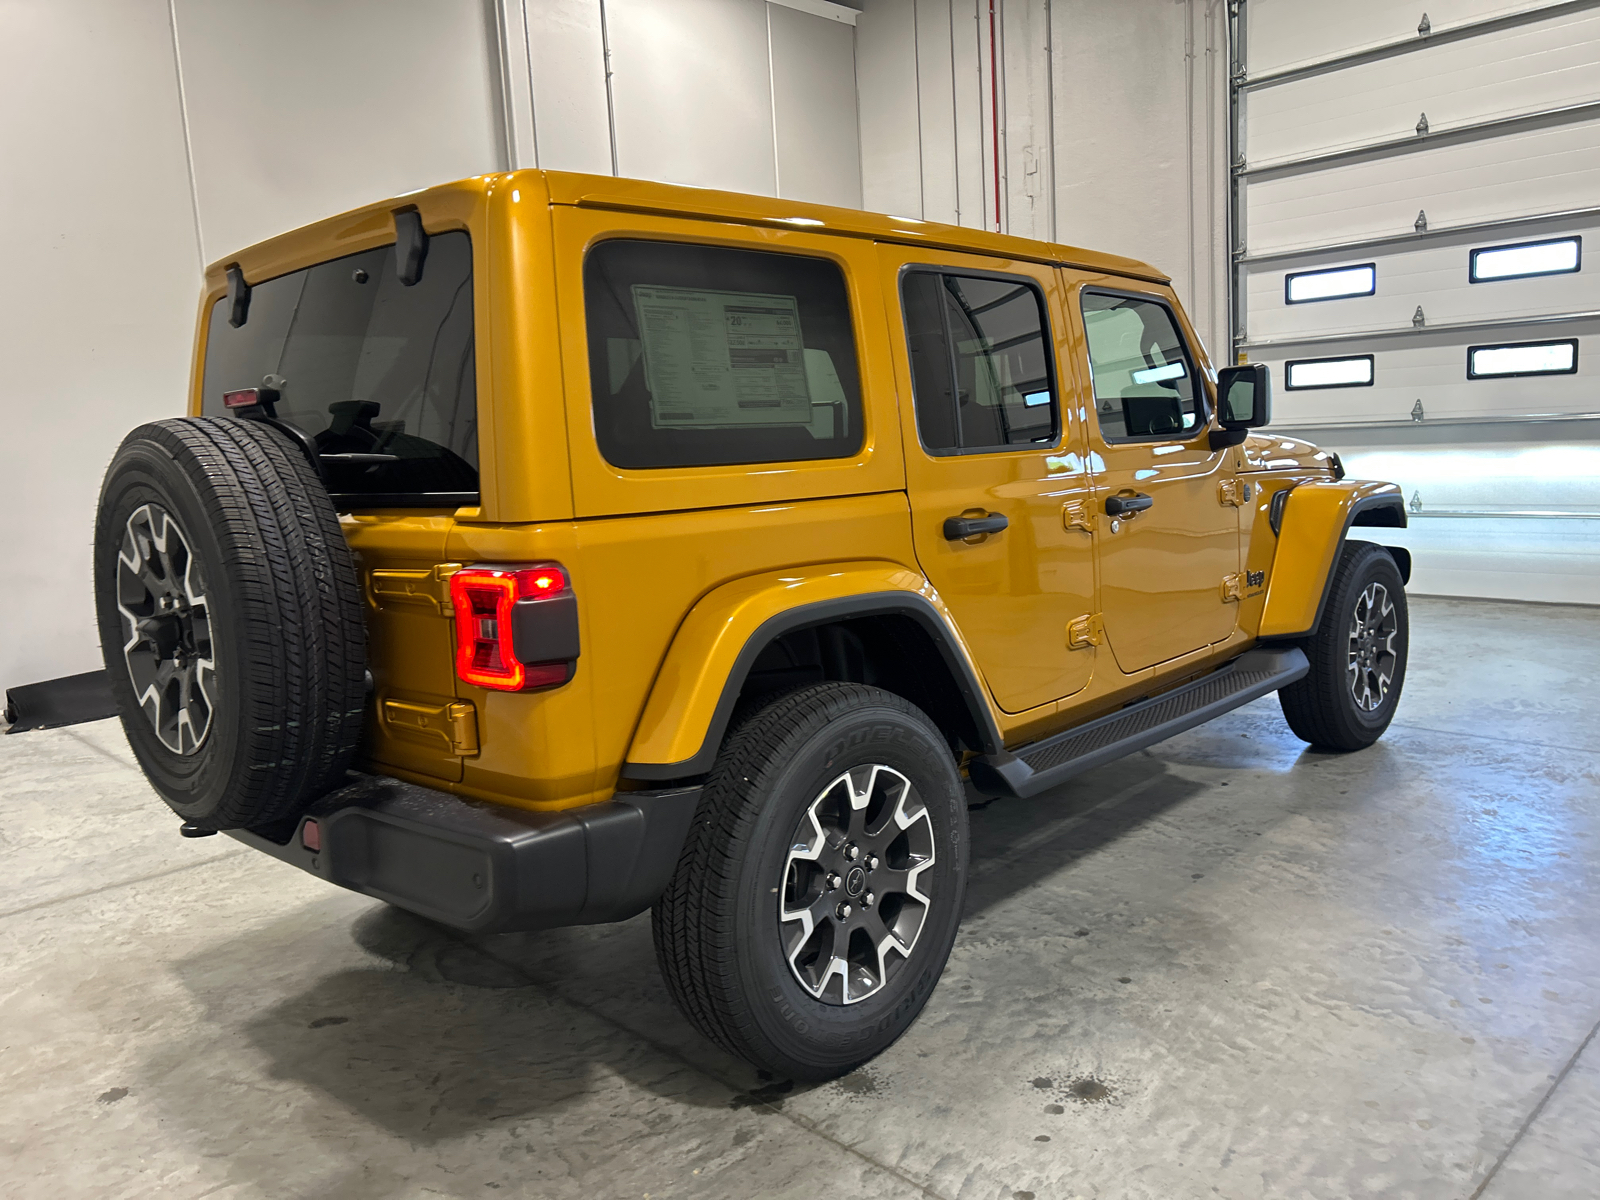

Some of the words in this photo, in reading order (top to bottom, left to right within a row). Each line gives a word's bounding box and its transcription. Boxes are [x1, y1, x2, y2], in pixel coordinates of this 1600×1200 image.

[730, 316, 742, 326] 20
[1246, 569, 1264, 588] Jeep
[824, 725, 944, 777] DUELER
